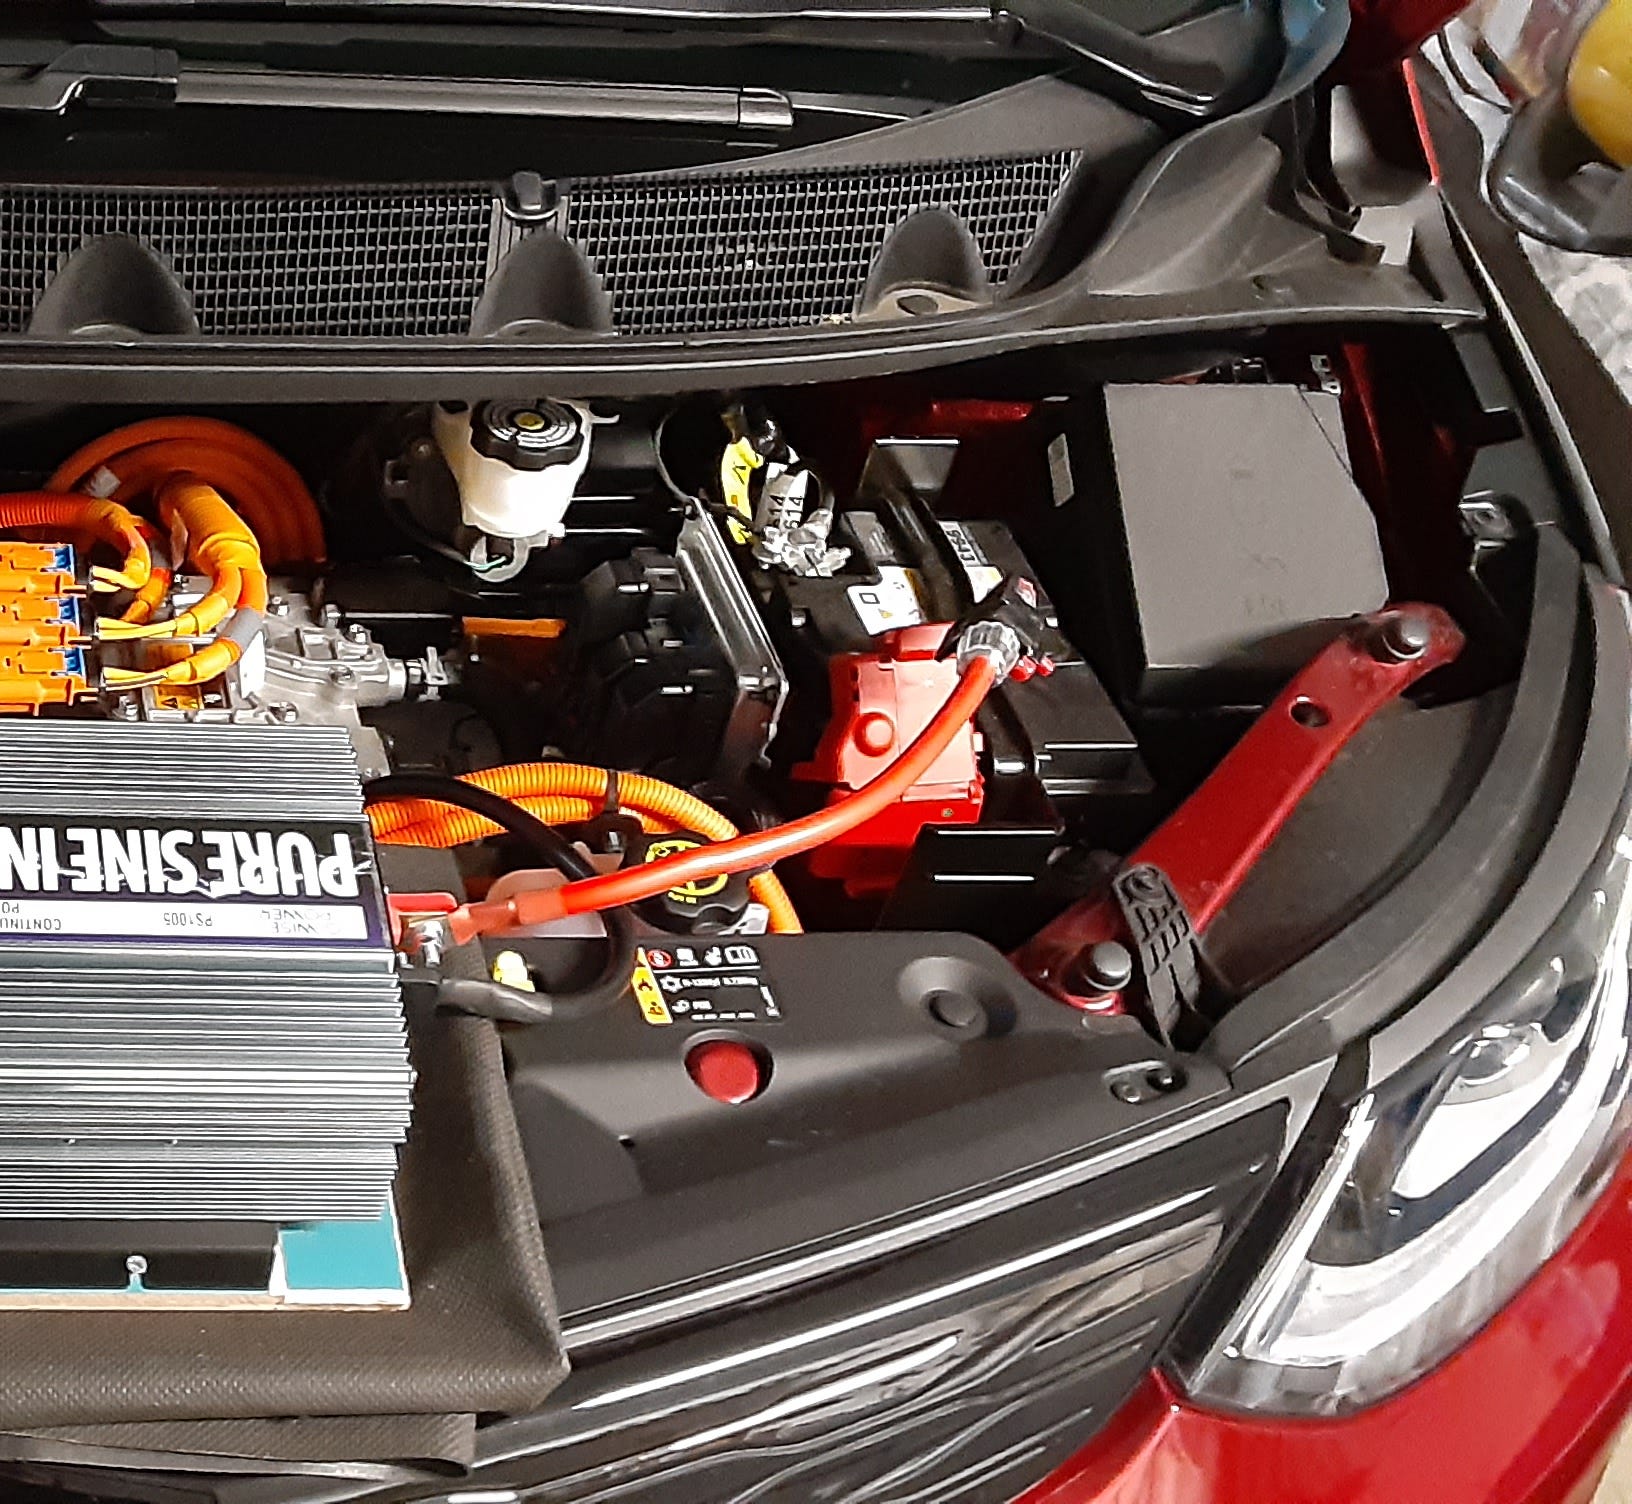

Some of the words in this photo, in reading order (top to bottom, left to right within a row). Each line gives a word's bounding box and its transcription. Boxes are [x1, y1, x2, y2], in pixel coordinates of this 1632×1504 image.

[65, 827, 198, 894] SINE
[202, 829, 360, 898] PURE
[162, 912, 213, 927] PS1005
